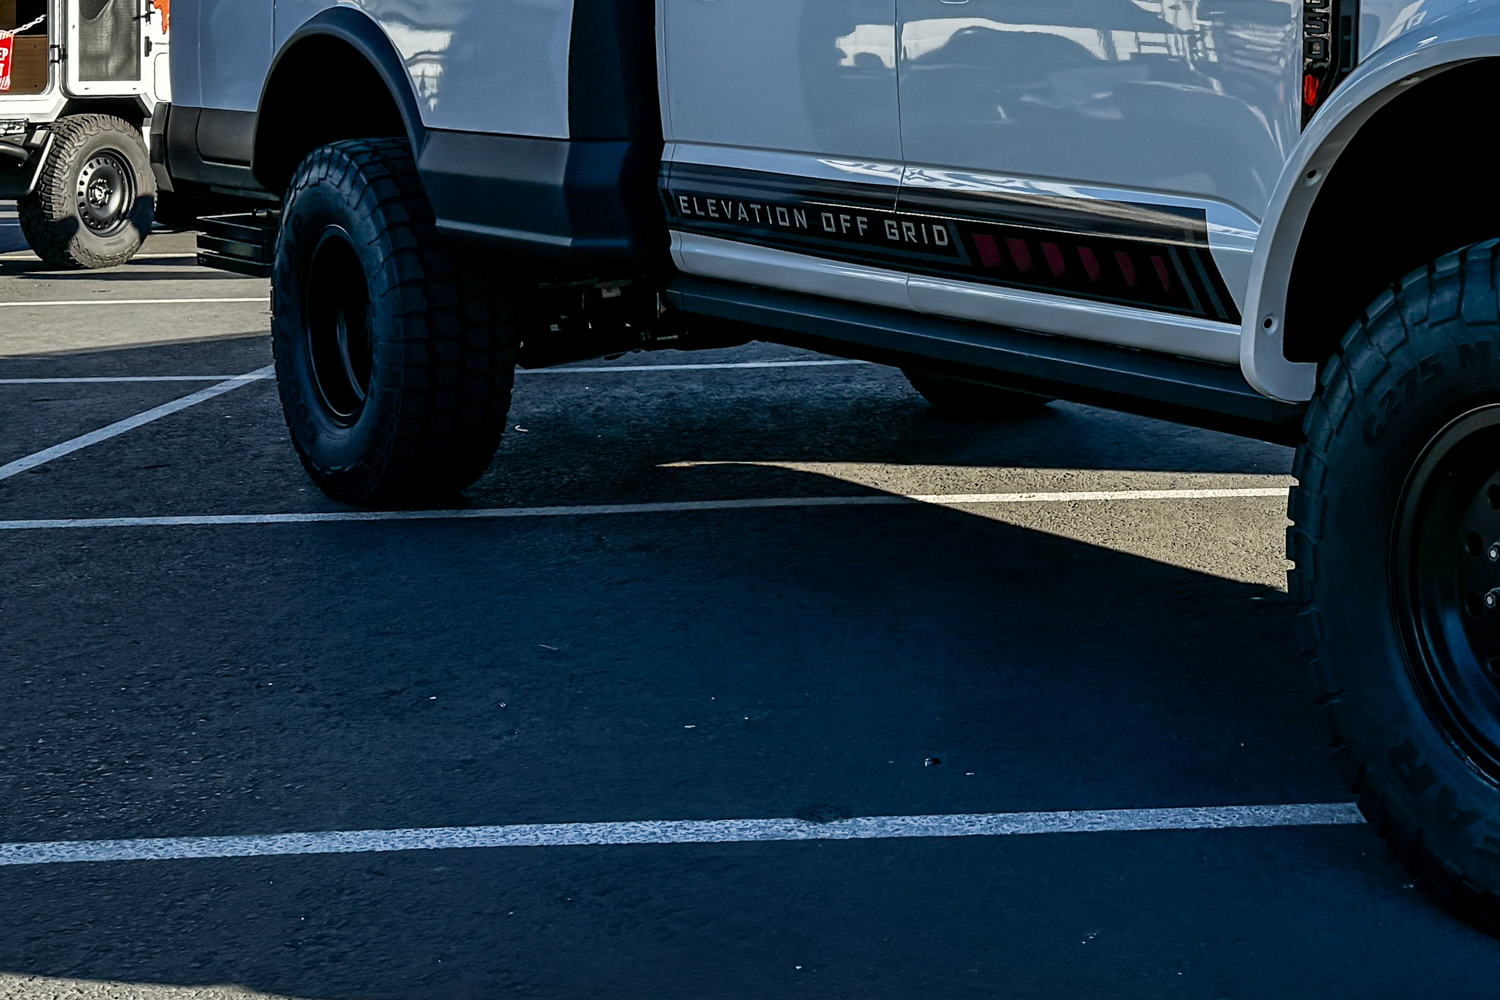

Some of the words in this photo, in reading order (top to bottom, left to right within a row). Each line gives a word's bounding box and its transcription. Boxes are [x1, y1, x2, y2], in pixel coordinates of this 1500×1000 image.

[678, 195, 808, 230] ELEVATION
[821, 211, 868, 237] OFF
[884, 219, 949, 247] GRID
